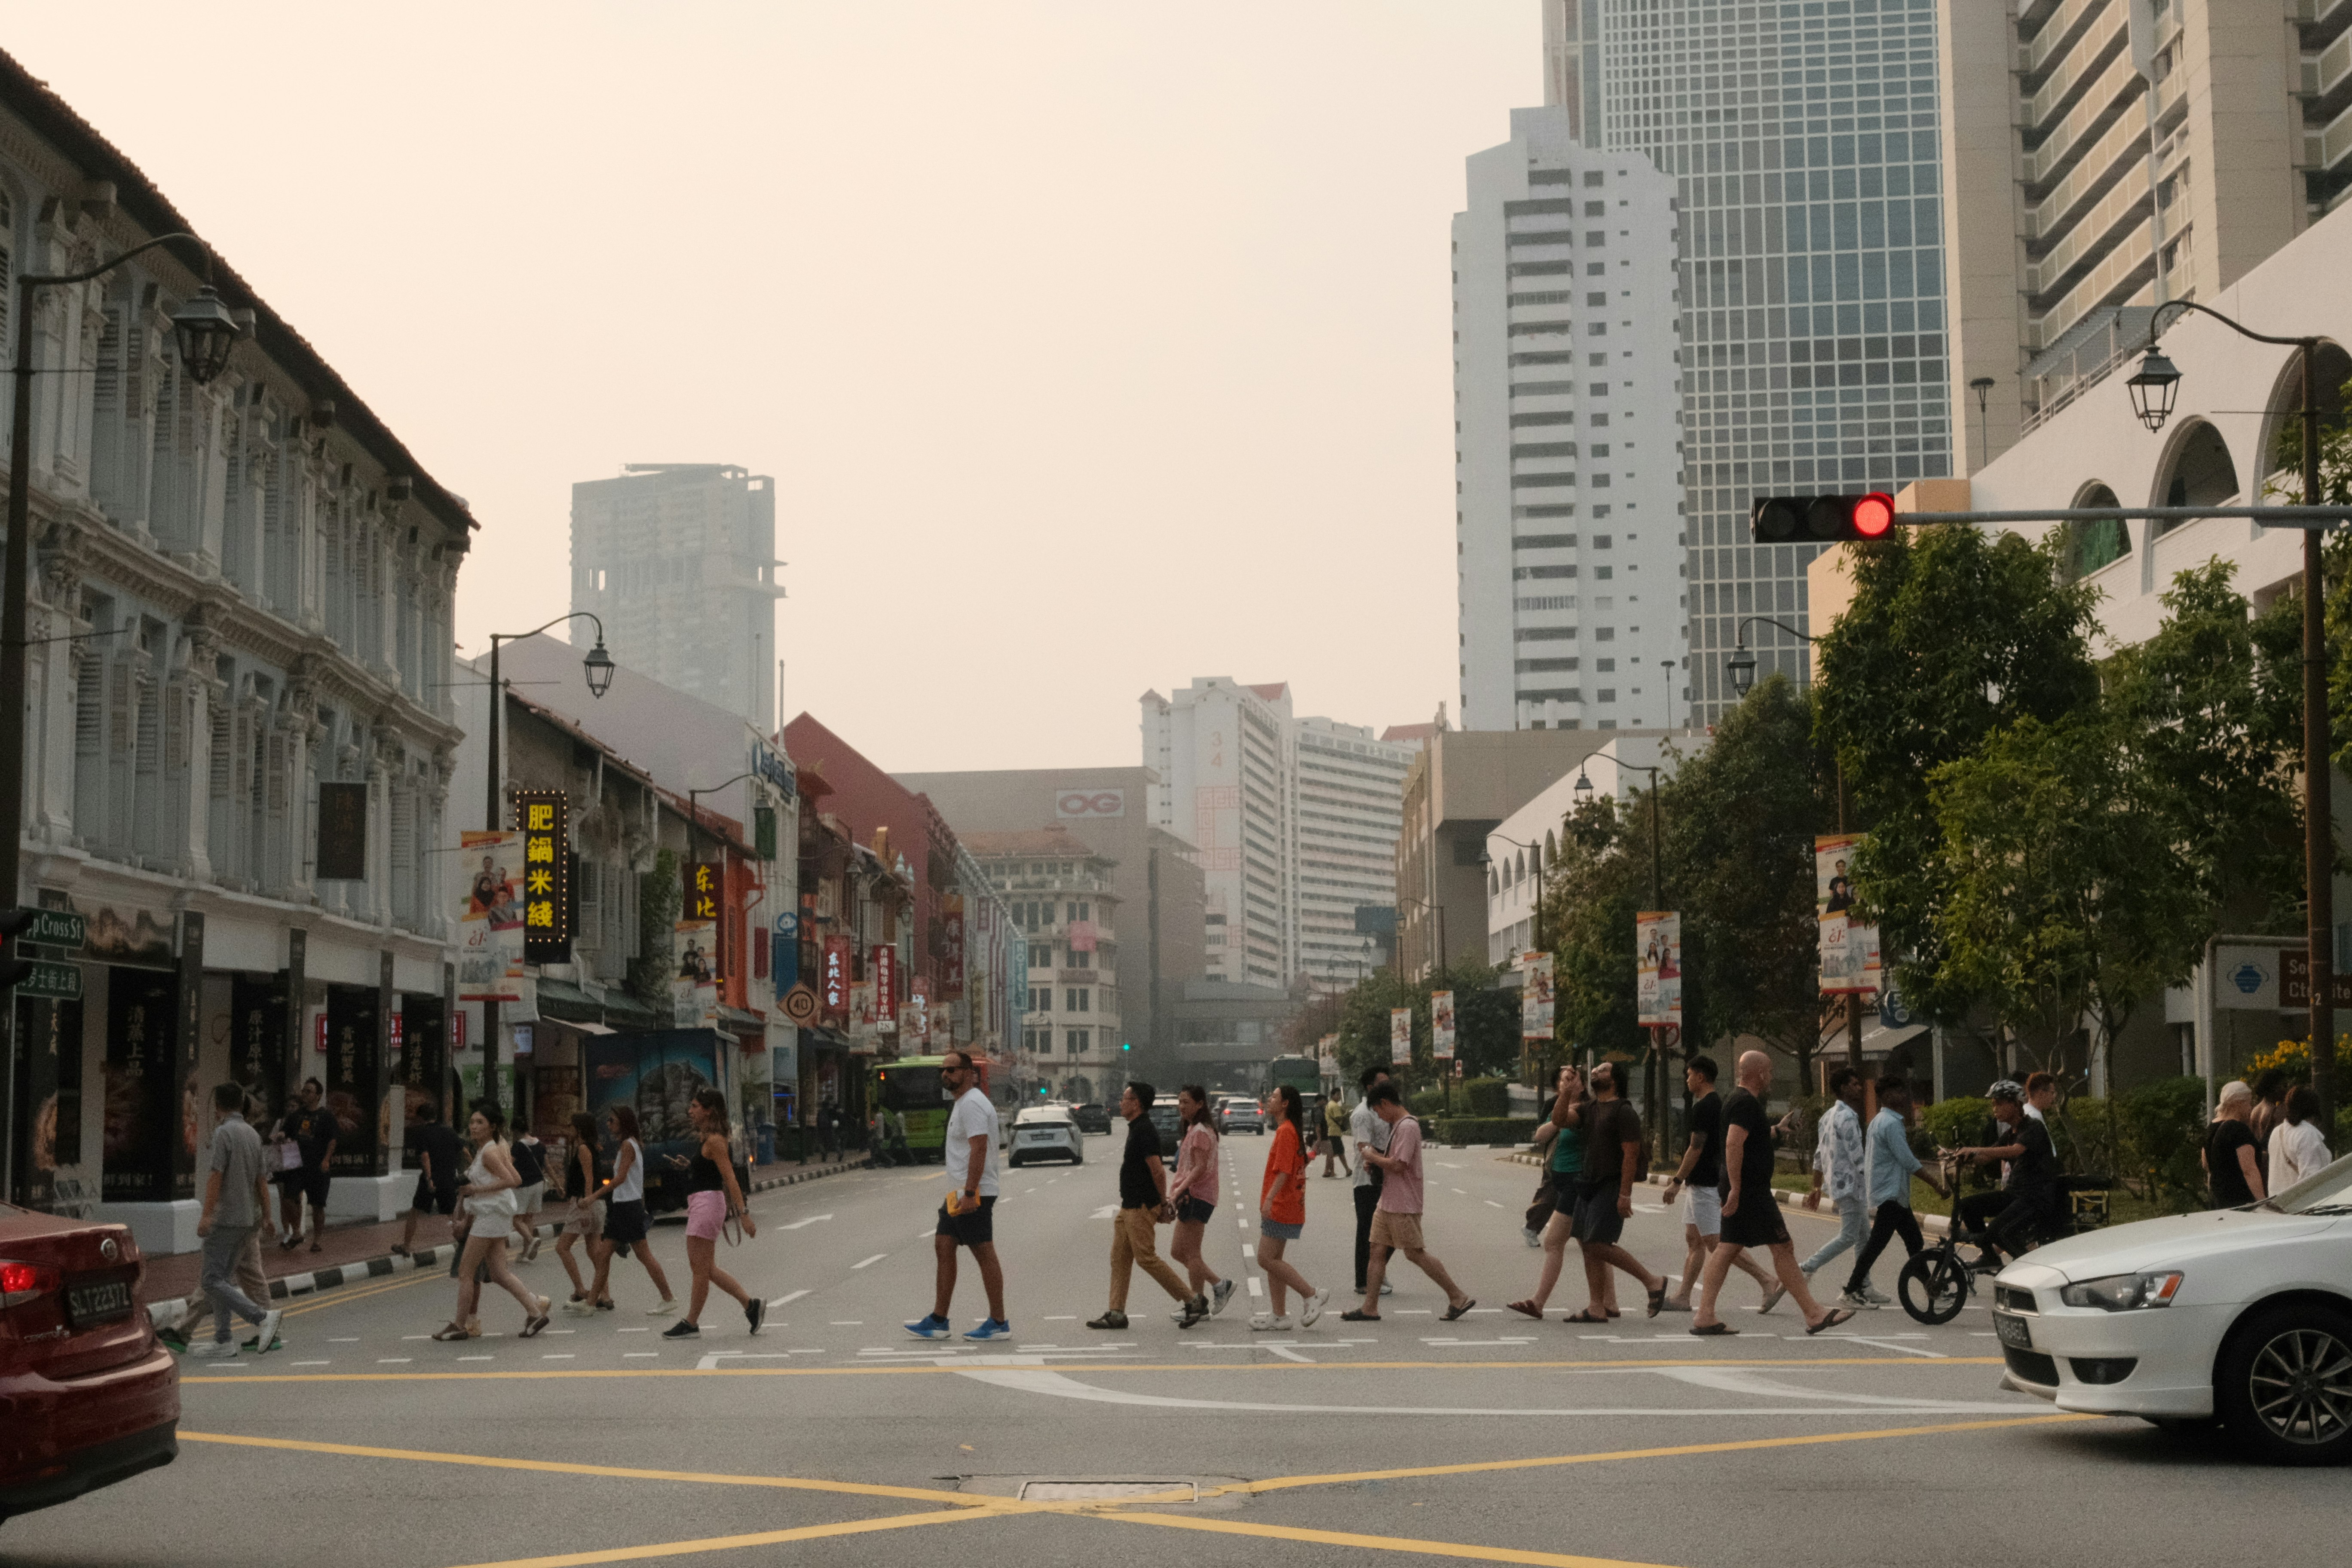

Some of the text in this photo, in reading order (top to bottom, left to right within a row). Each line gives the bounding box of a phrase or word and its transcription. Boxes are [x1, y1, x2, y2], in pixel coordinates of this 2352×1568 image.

[41, 913, 68, 937] Cross
[70, 917, 81, 940] St
[1016, 943, 1025, 992] NOTEL
[2289, 959, 2309, 974] So
[793, 998, 808, 1011] 40
[2314, 992, 2322, 1006] 2
[245, 1009, 263, 1075] 原汁原味
[69, 1282, 130, 1317] SLT2237Z
